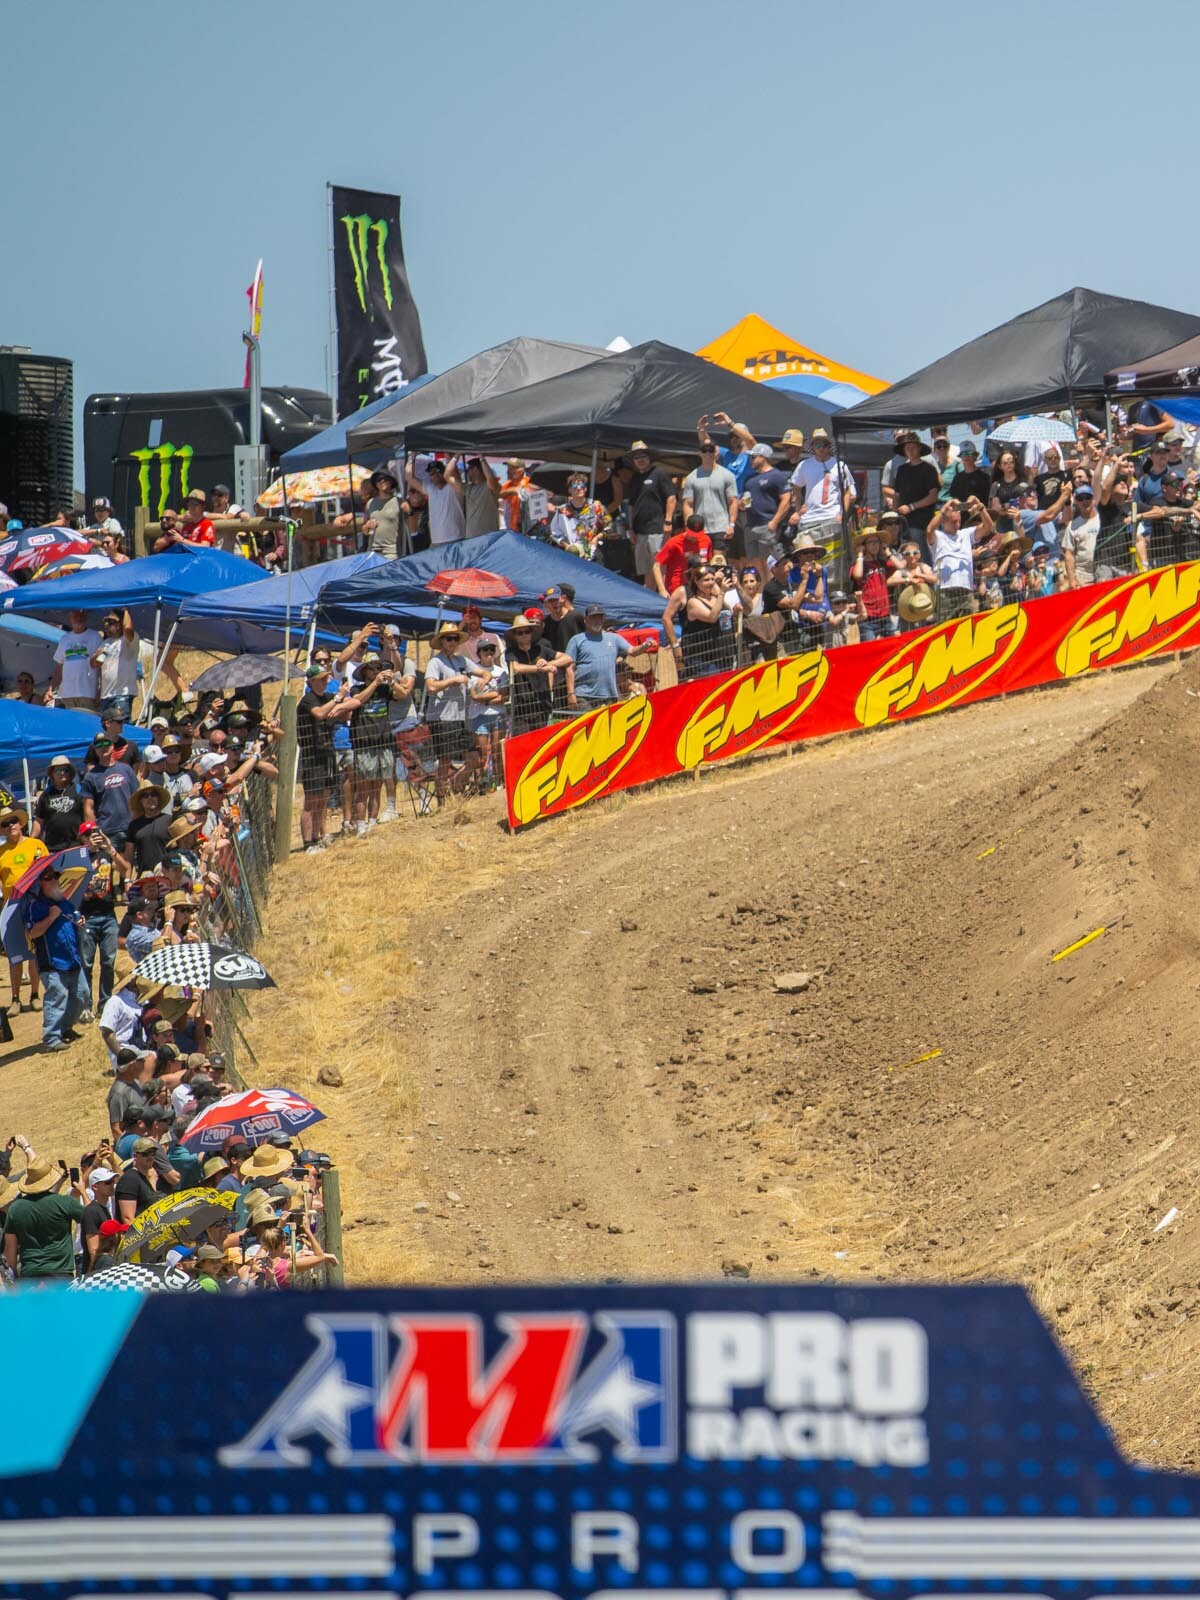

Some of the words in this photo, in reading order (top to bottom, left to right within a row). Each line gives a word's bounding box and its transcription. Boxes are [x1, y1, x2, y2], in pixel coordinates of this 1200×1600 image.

[685, 650, 823, 770] FMF
[864, 602, 1020, 728] FMF
[520, 695, 648, 824] FMF
[218, 1311, 678, 1467] AMA
[686, 1311, 929, 1414] PRO
[686, 1411, 929, 1467] RACING
